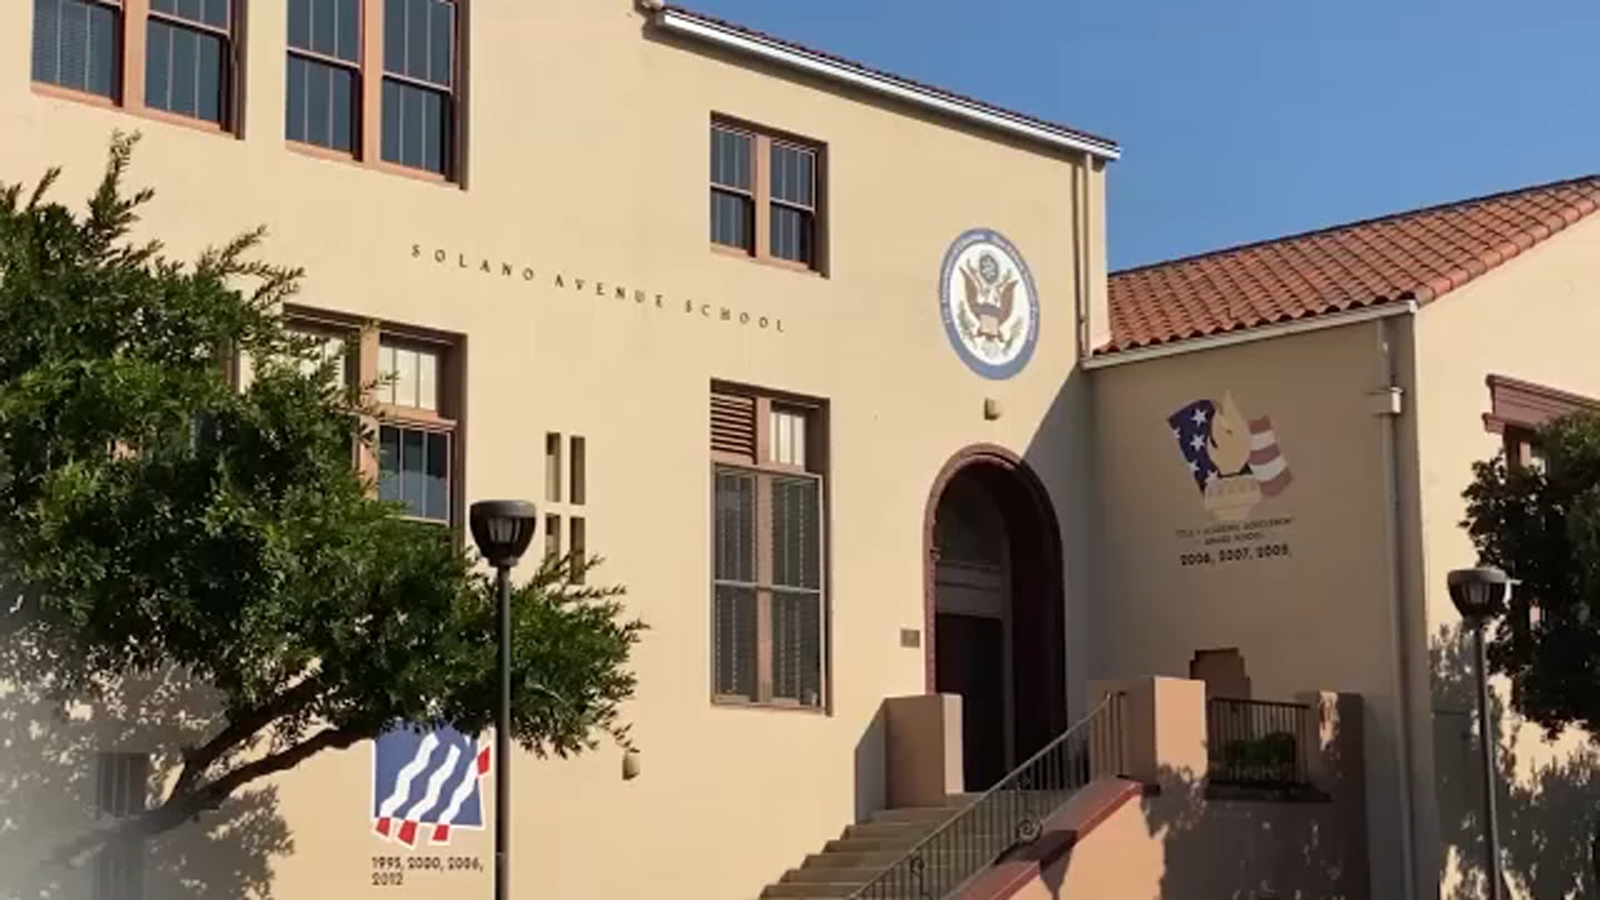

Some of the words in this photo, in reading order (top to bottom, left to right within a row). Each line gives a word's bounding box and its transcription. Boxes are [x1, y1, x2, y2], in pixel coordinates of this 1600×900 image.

[411, 243, 535, 282] SOLANO
[554, 273, 664, 308] AVENUE
[685, 299, 785, 333] SCHOOL
